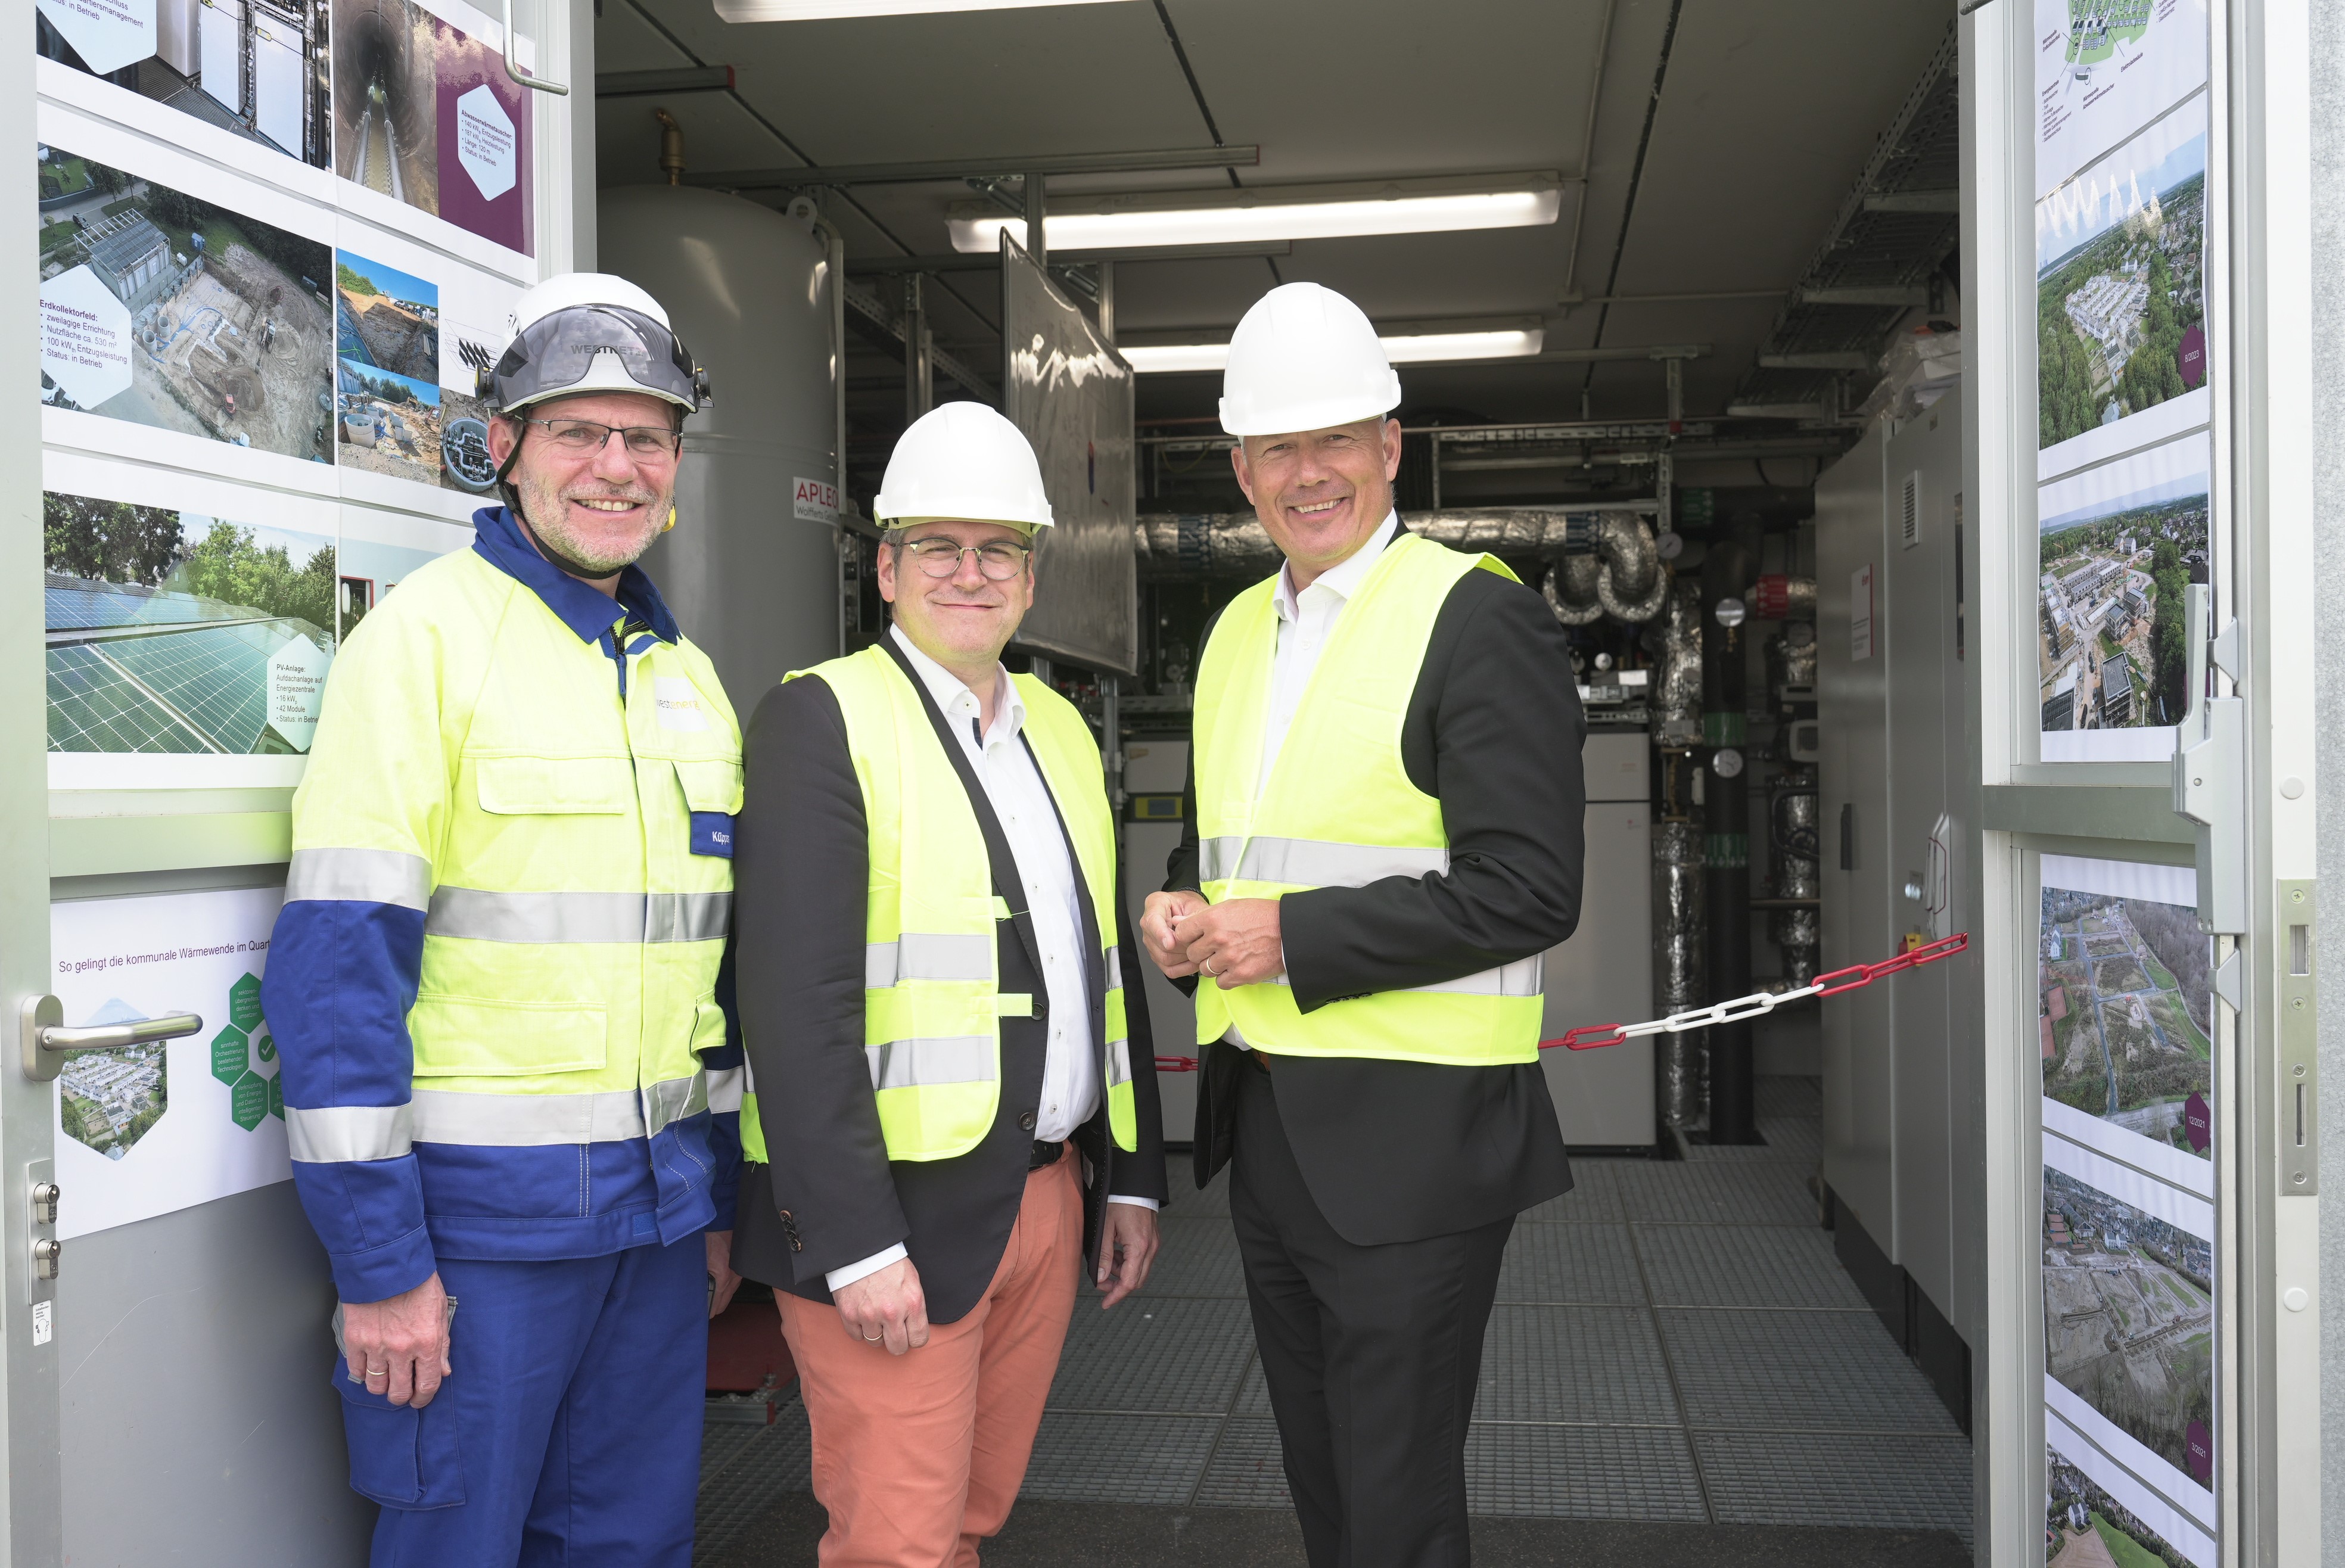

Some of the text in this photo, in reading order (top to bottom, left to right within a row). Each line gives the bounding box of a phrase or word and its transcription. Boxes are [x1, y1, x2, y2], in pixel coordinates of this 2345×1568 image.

[69, 1, 74, 10] in
[77, 4, 100, 20] Betrieb
[80, 0, 143, 28] artiersmanagement
[462, 110, 512, 140] Abwasserwärmetauscher:
[481, 128, 511, 149] Entzugsleistung
[482, 137, 505, 154] Heizleistung
[465, 146, 478, 158] Status:
[483, 155, 497, 167] Betrieb
[40, 299, 98, 322] Erdkollektorfeld:
[46, 314, 116, 339] zweilagige Errichtung
[47, 325, 117, 349] Nutzfläche ca. 530 m²
[46, 348, 102, 368] Status: in Betrieb
[48, 337, 59, 347] 100
[77, 344, 127, 365] Entzugsleistung
[2185, 350, 2199, 362] 8/2023
[797, 481, 839, 509] APLEO
[276, 664, 306, 674] PV-Anlage:
[276, 674, 313, 685] Aufdachanlage
[276, 684, 315, 693] Energiezentrale
[59, 939, 270, 973] So gelingt die kommunale Wärmewende im Quart
[217, 1063, 244, 1073] Technologien
[238, 1082, 262, 1091] Verknüpfung
[240, 1113, 261, 1122] Steuerung
[2189, 1116, 2204, 1129] 12/2021
[2192, 1442, 2206, 1458] 3/2021
